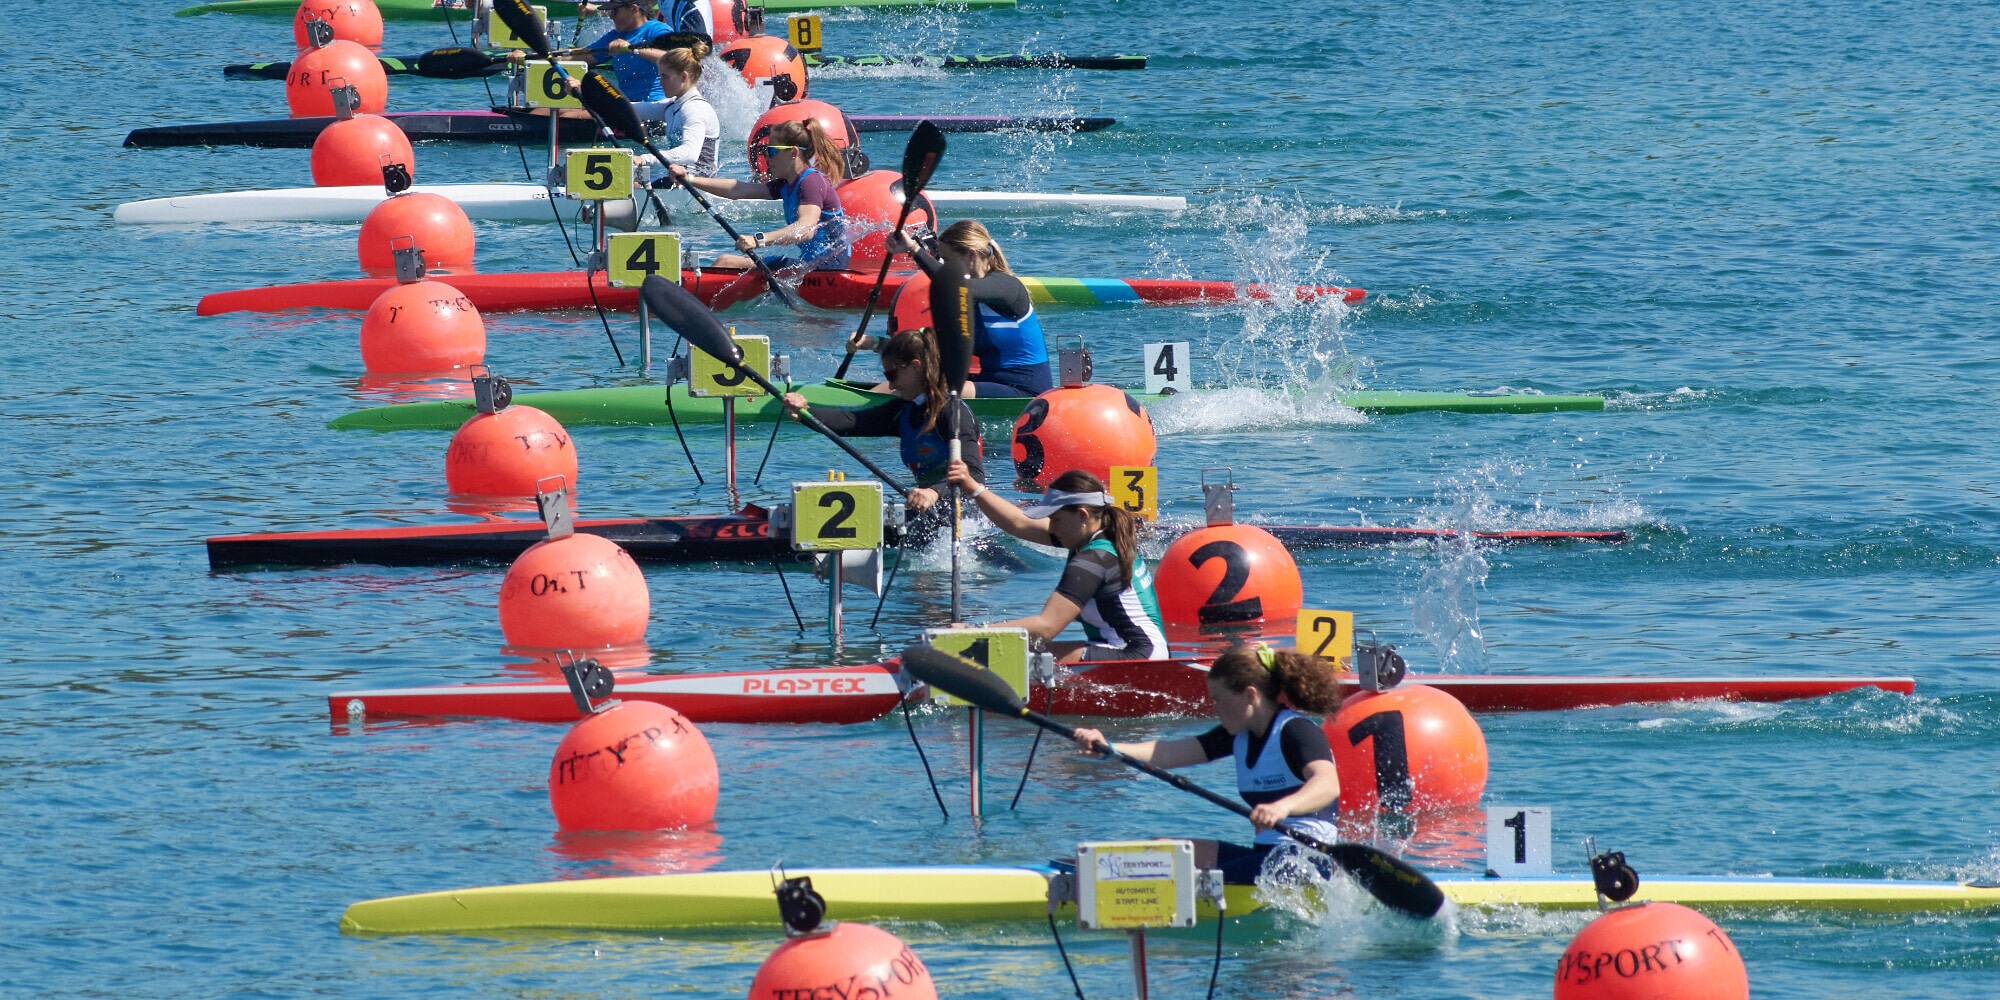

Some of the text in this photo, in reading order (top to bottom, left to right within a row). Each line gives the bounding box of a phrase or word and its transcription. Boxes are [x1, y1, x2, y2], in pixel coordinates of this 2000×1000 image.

[797, 18, 812, 45] 8
[542, 67, 570, 99] 6
[584, 155, 613, 190] 5
[626, 239, 660, 276] 4
[712, 344, 748, 387] 3
[1153, 344, 1178, 382] 4
[1012, 398, 1050, 479] 3
[1123, 470, 1144, 512] 3
[818, 491, 857, 539] 2
[1188, 540, 1263, 625] 2
[1312, 616, 1337, 662] 2
[742, 677, 866, 694] PLASTEX
[1348, 710, 1413, 810] 1
[1504, 811, 1526, 863] 1
